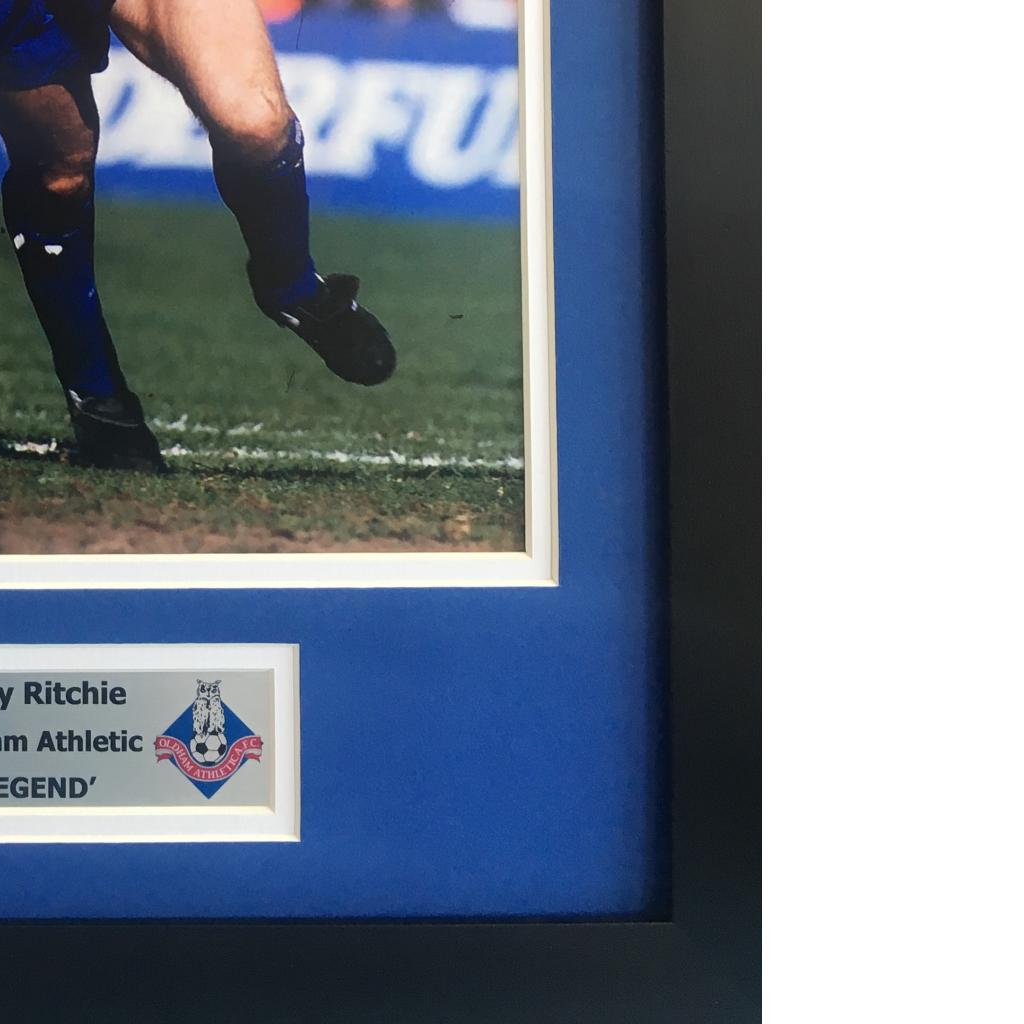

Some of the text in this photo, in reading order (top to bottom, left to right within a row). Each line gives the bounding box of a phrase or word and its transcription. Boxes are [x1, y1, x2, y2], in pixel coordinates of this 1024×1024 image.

[24, 679, 127, 706] Ritchie
[37, 729, 144, 754] Athletic
[159, 738, 194, 773] OLDHAM
[193, 752, 240, 780] ATHLETIC
